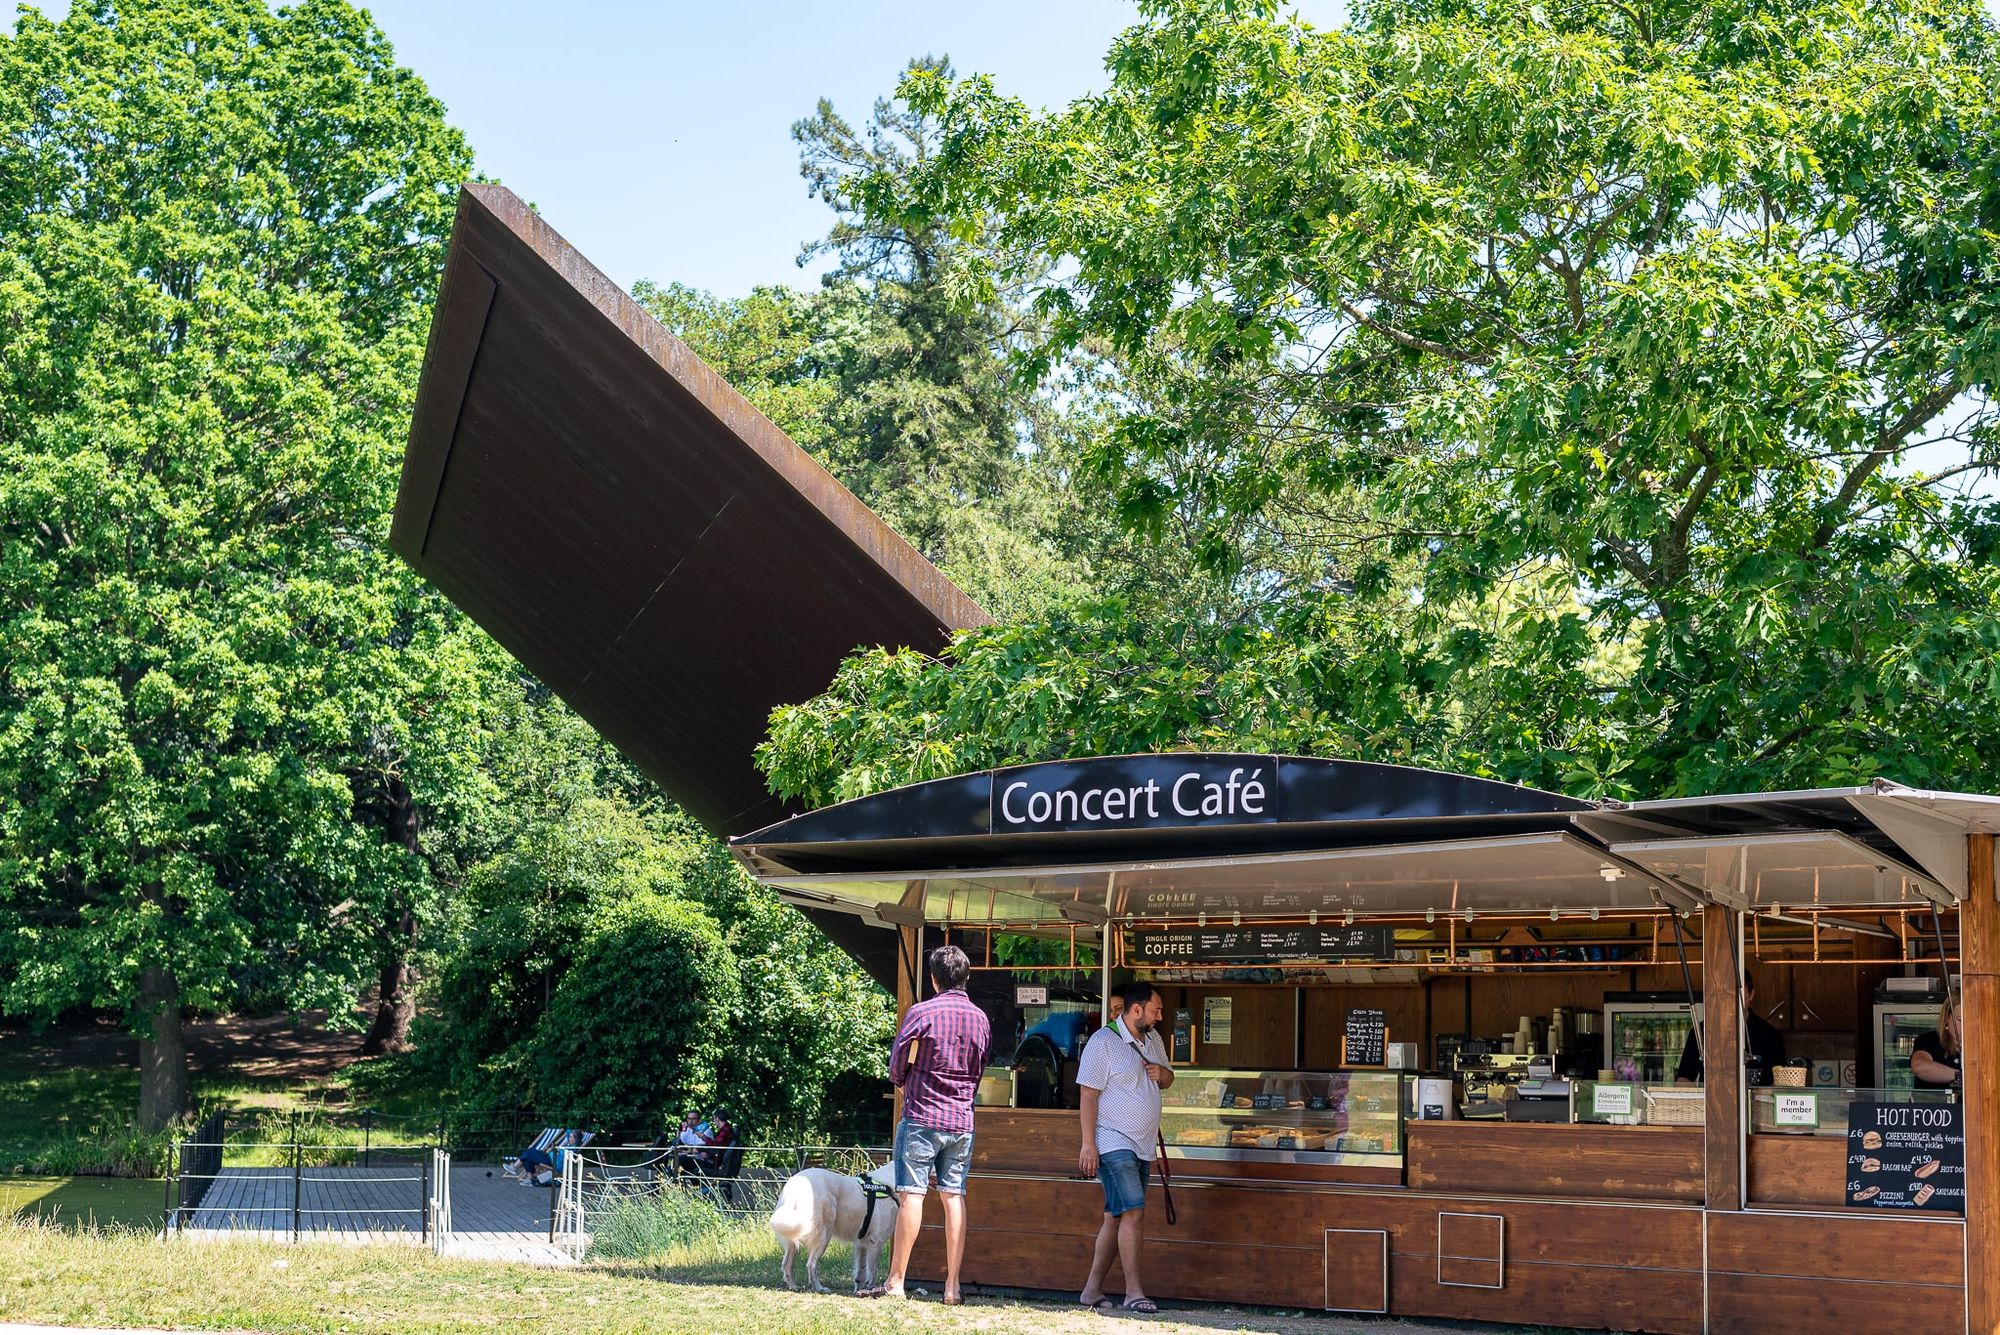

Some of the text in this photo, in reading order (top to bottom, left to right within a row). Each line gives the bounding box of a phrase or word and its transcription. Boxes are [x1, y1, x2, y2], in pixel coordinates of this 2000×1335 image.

[1002, 768, 1266, 824] Concert Café
[1145, 944, 1193, 955] COFFEE
[1597, 1092, 1628, 1100] Allergens
[1786, 1098, 1798, 1106] I'm
[1876, 1108, 1952, 1127] HOT FOOD
[1849, 1128, 1864, 1138] £6
[1885, 1132, 1930, 1142] CHEESEBURGER
[1931, 1134, 1944, 1142] with
[1911, 1155, 1933, 1164] £4.50
[1847, 1180, 1861, 1191] £6
[1879, 1192, 1904, 1200] PIZZINI
[1935, 1188, 1960, 1196] SAUSAGE
